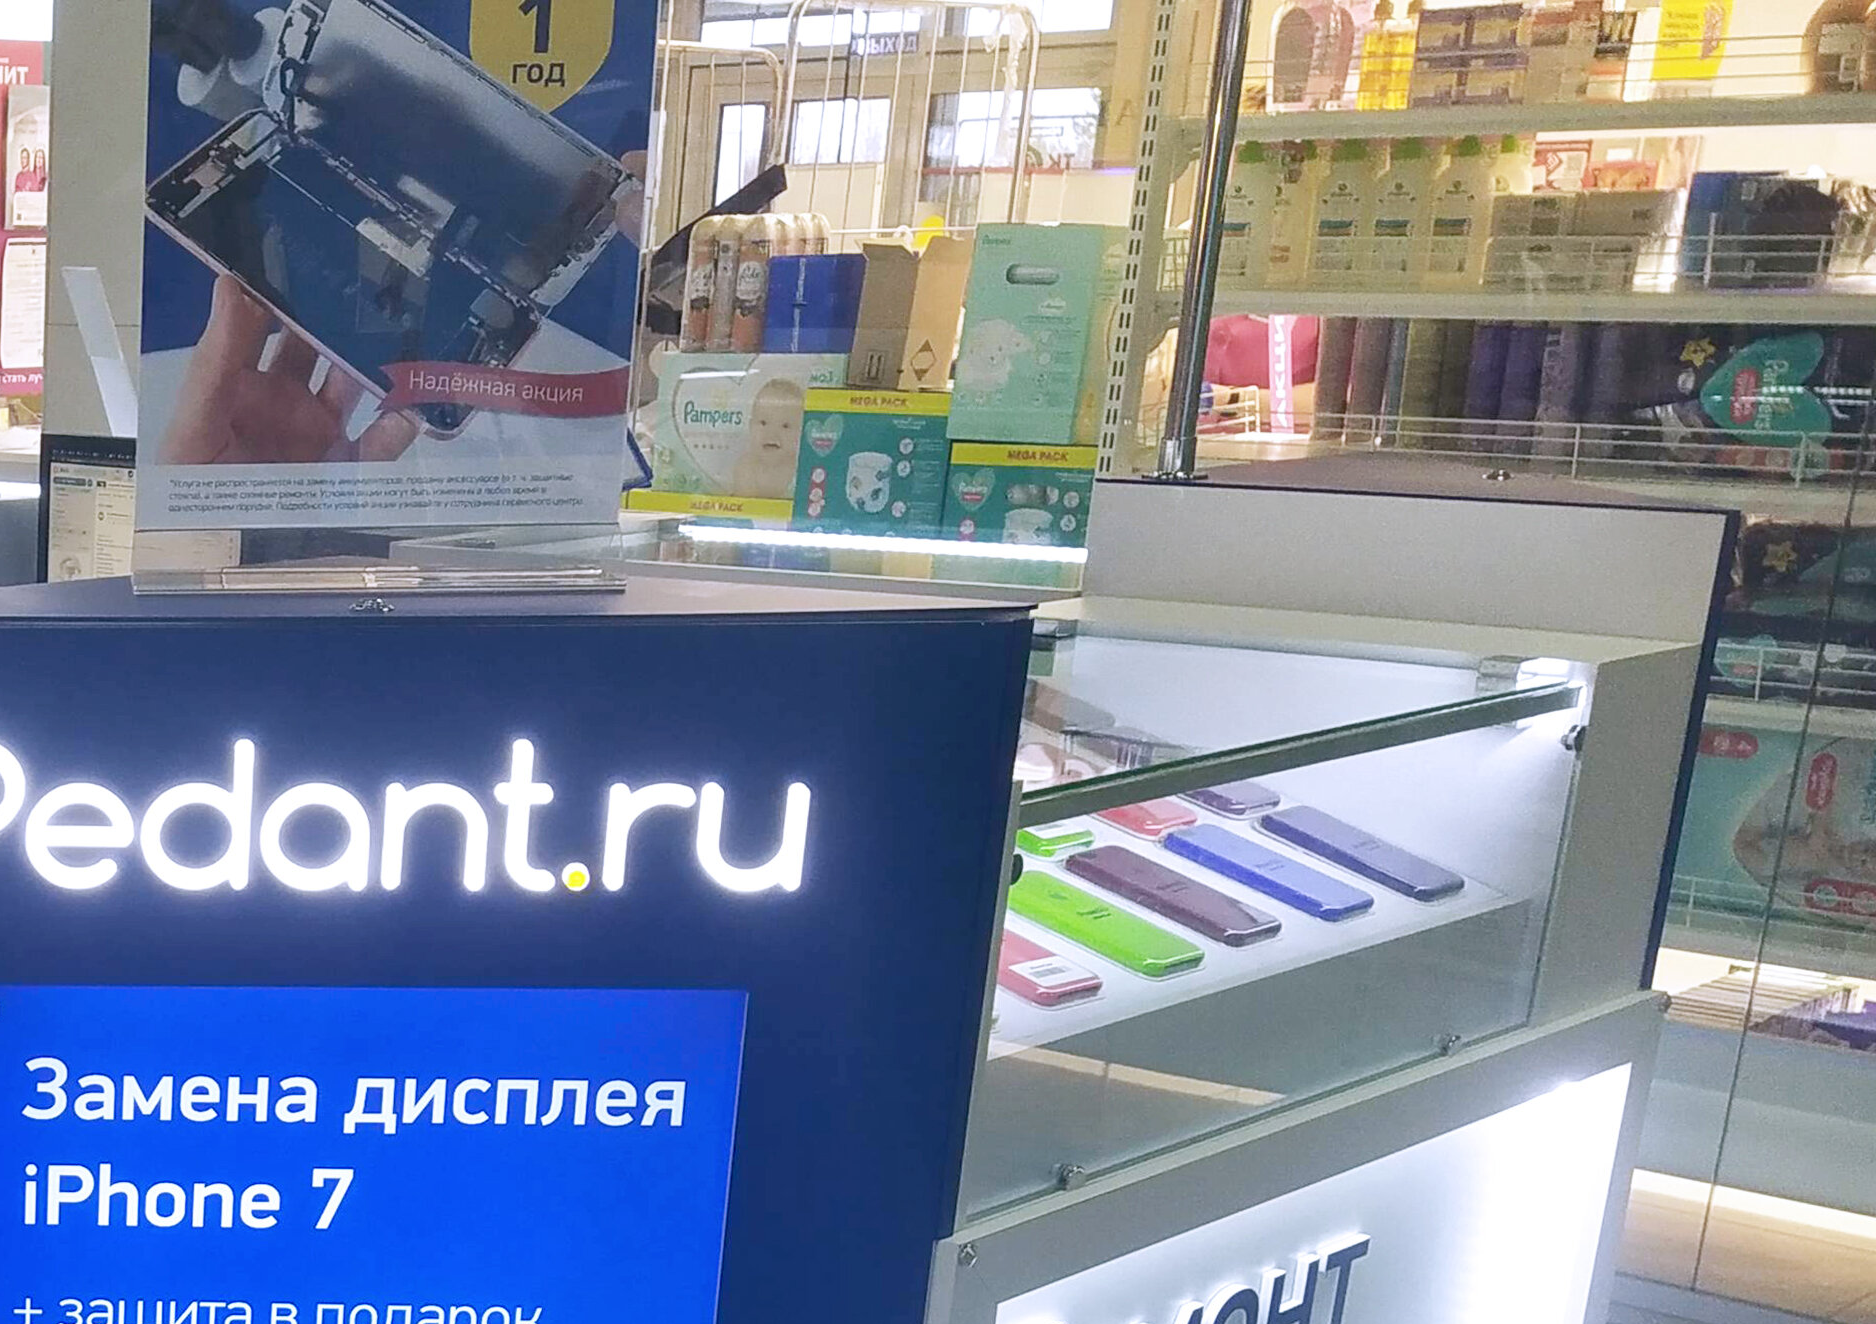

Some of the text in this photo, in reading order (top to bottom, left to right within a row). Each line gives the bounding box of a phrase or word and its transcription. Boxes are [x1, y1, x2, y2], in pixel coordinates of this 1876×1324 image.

[518, 0, 552, 53] 1
[512, 63, 565, 87] год
[408, 370, 584, 405] Надёжная акция
[880, 396, 909, 408] PACK
[1754, 360, 1790, 431] Pamers
[683, 400, 744, 427] Pampers
[1006, 449, 1069, 463] MEGA PACK
[717, 502, 744, 513] PACK
[22, 1055, 686, 1134] Замена дисплея
[24, 1163, 355, 1230] iPhone 7
